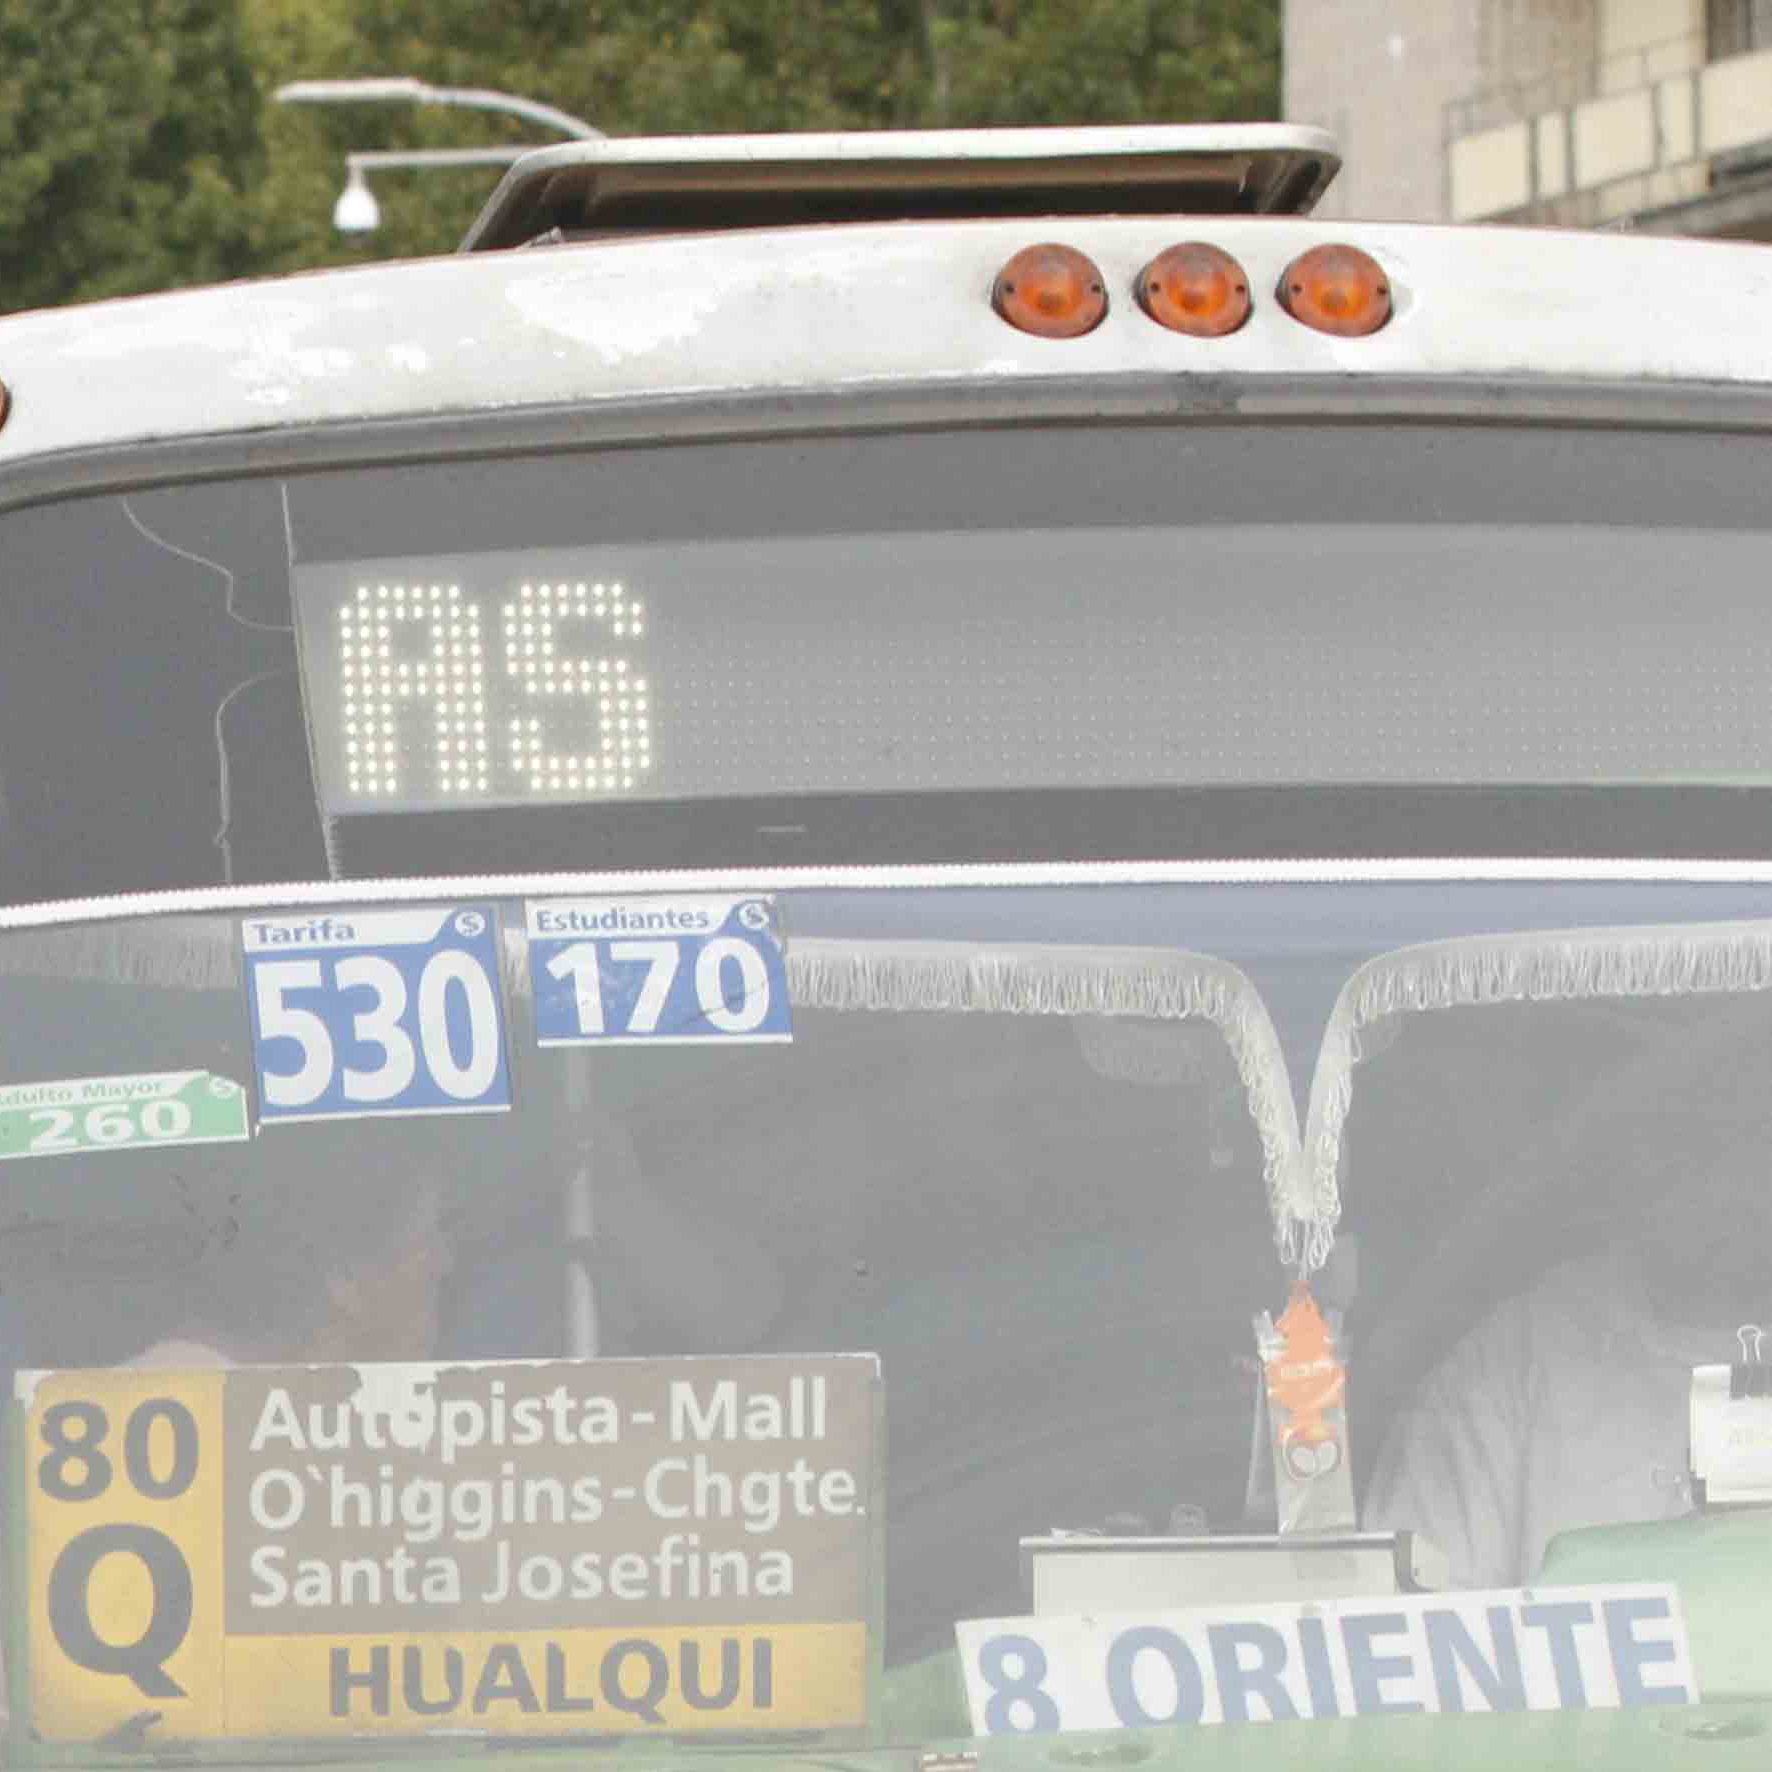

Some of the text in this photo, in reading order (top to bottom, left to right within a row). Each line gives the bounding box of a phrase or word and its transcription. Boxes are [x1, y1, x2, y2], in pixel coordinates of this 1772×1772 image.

[338, 579, 652, 793] AS
[253, 918, 356, 946] Tarifa
[536, 906, 710, 932] Estudiantes
[254, 949, 499, 1106] 530
[545, 937, 770, 1034] 170
[29, 1099, 192, 1151] 260
[82, 1080, 162, 1099] Mayor
[37, 1397, 200, 1503] 80
[47, 1522, 193, 1700] Q
[250, 1533, 794, 1608] Santa Josefina
[329, 1637, 773, 1725] HUALQUI
[977, 1597, 1688, 1737] 8 ORIENTE
